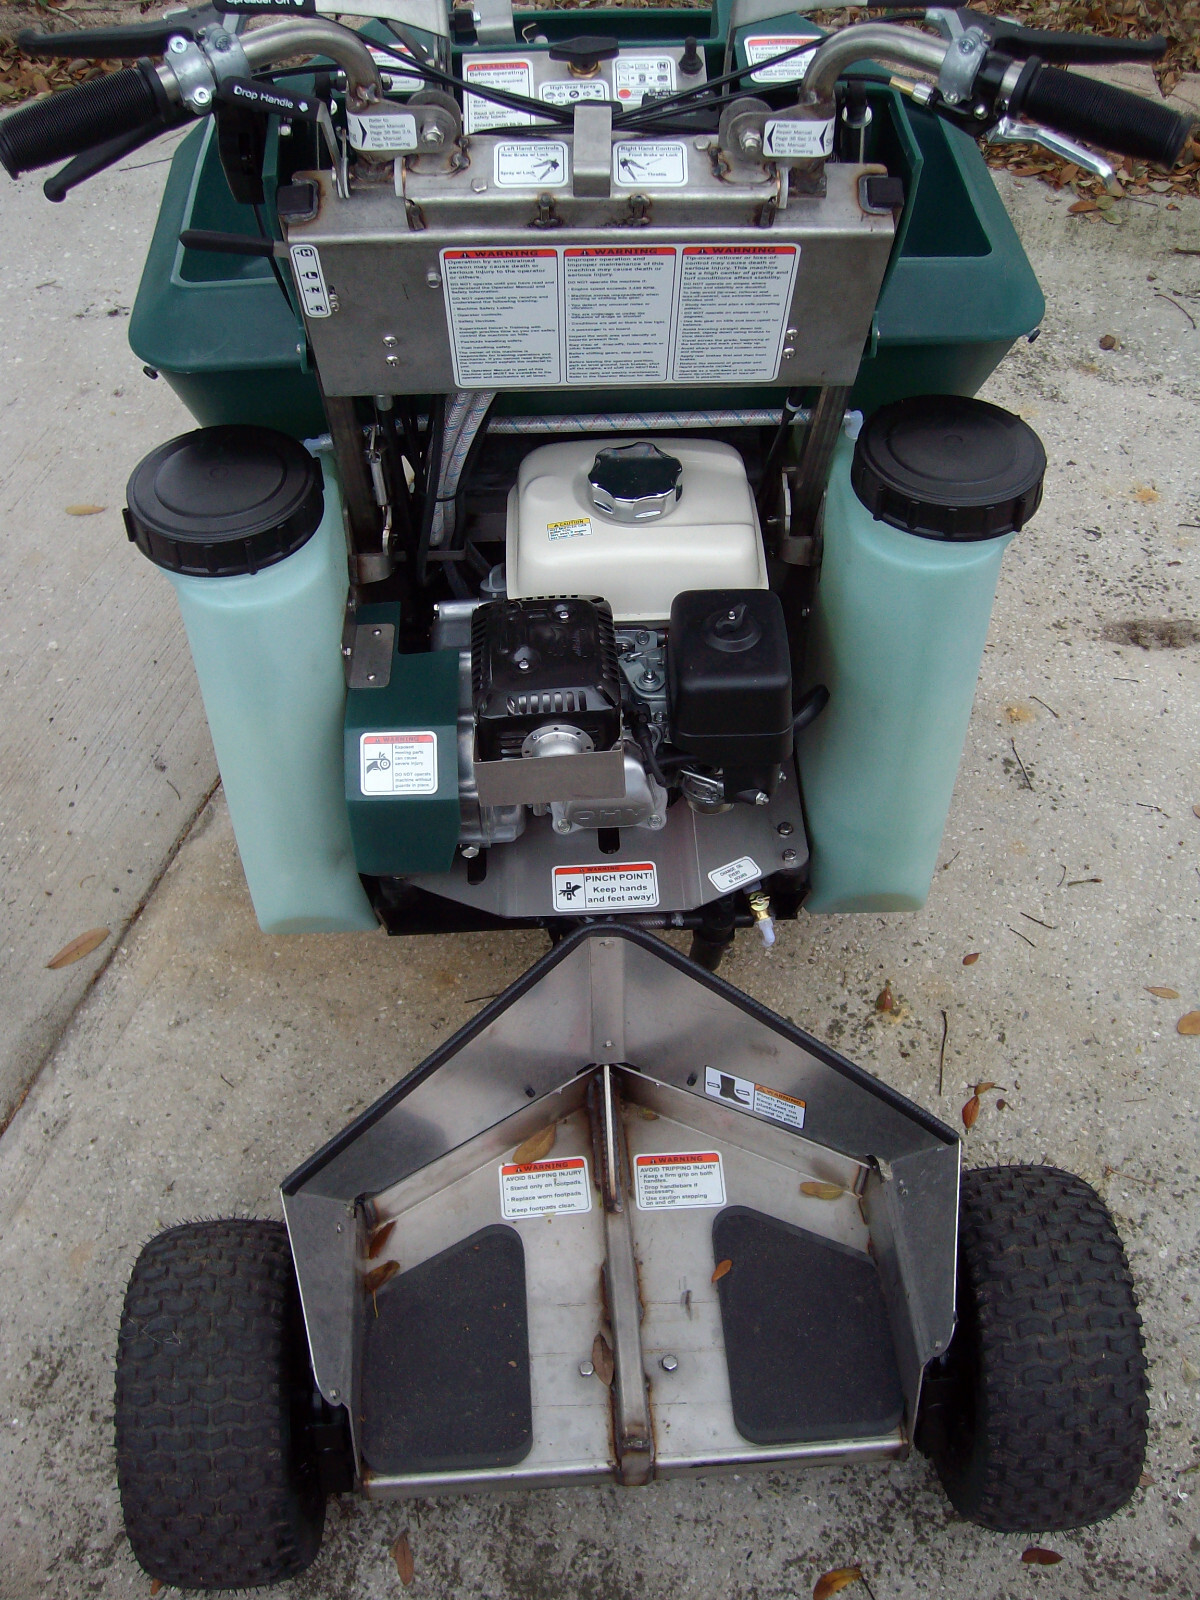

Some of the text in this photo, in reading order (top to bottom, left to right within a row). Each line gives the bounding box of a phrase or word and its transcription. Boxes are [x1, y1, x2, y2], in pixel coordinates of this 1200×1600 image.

[233, 85, 294, 108] Drop Handle
[757, 1092, 774, 1101] Pinch
[757, 1098, 772, 1106] Keep
[767, 1090, 801, 1105] WARNING
[756, 1103, 784, 1115] platform
[756, 1108, 774, 1116] guard
[784, 1116, 800, 1125] place
[524, 1162, 568, 1171] WARNING
